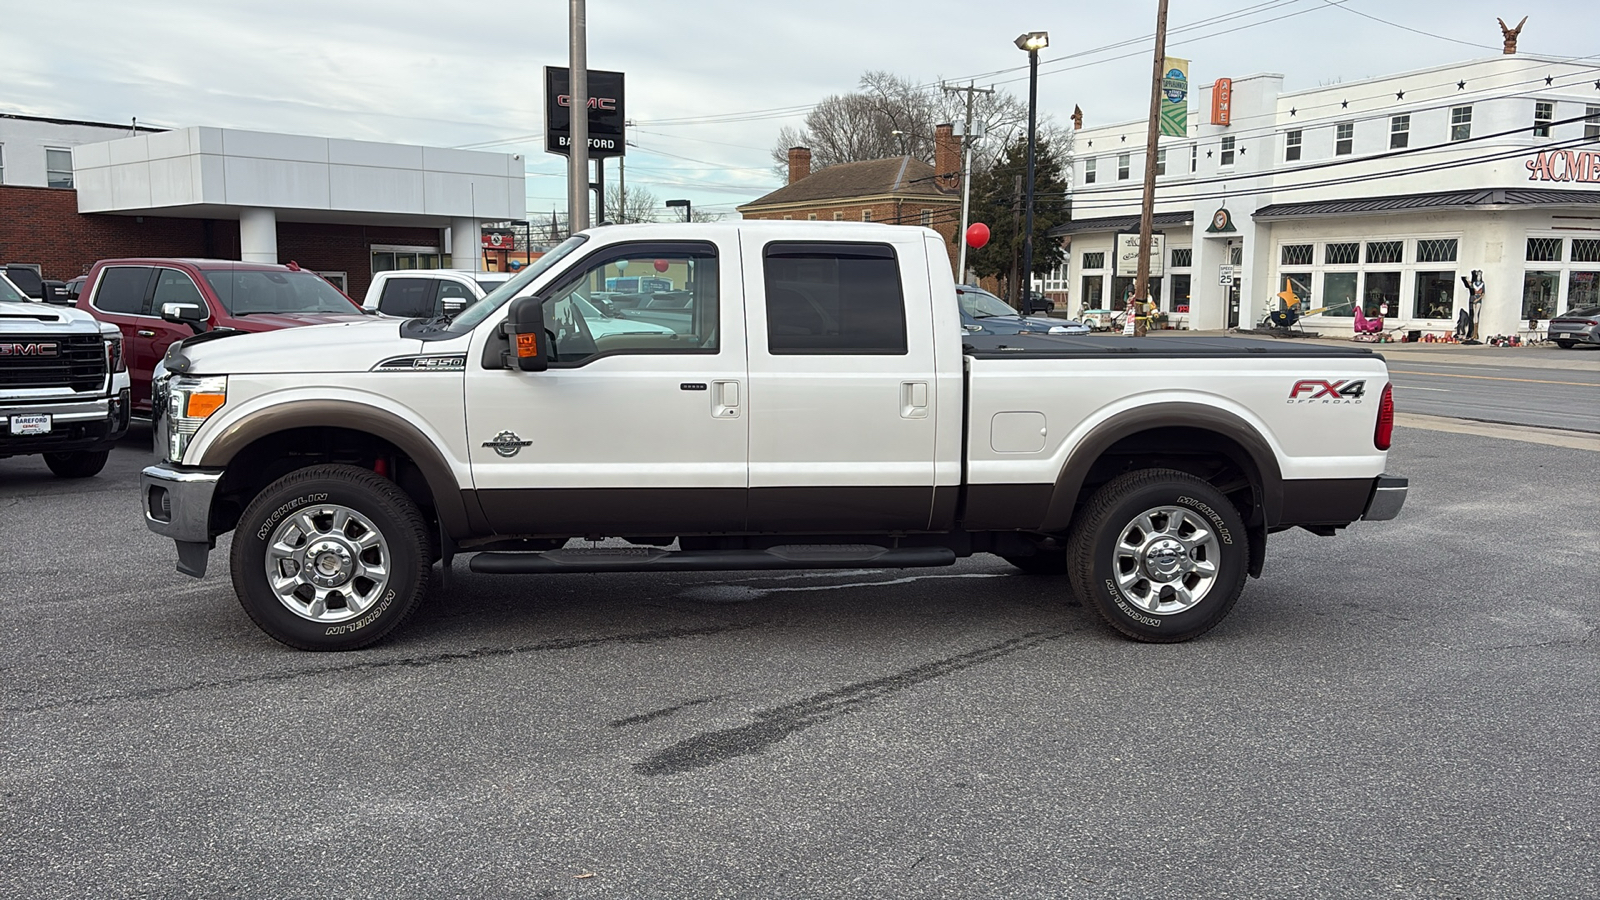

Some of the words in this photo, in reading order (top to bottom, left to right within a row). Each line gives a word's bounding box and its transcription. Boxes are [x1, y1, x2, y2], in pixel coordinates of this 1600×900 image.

[1220, 81, 1228, 122] ACME
[559, 136, 615, 149] BAFORD
[1525, 149, 1600, 183] ACME
[1220, 275, 1232, 283] 25
[0, 343, 57, 355] GMC
[1288, 379, 1367, 399] FX4
[257, 493, 329, 541] MICHELIN
[1176, 495, 1233, 545] MICHELIN
[325, 589, 396, 636] MICHELIN
[1105, 579, 1162, 628] MICHELIN
